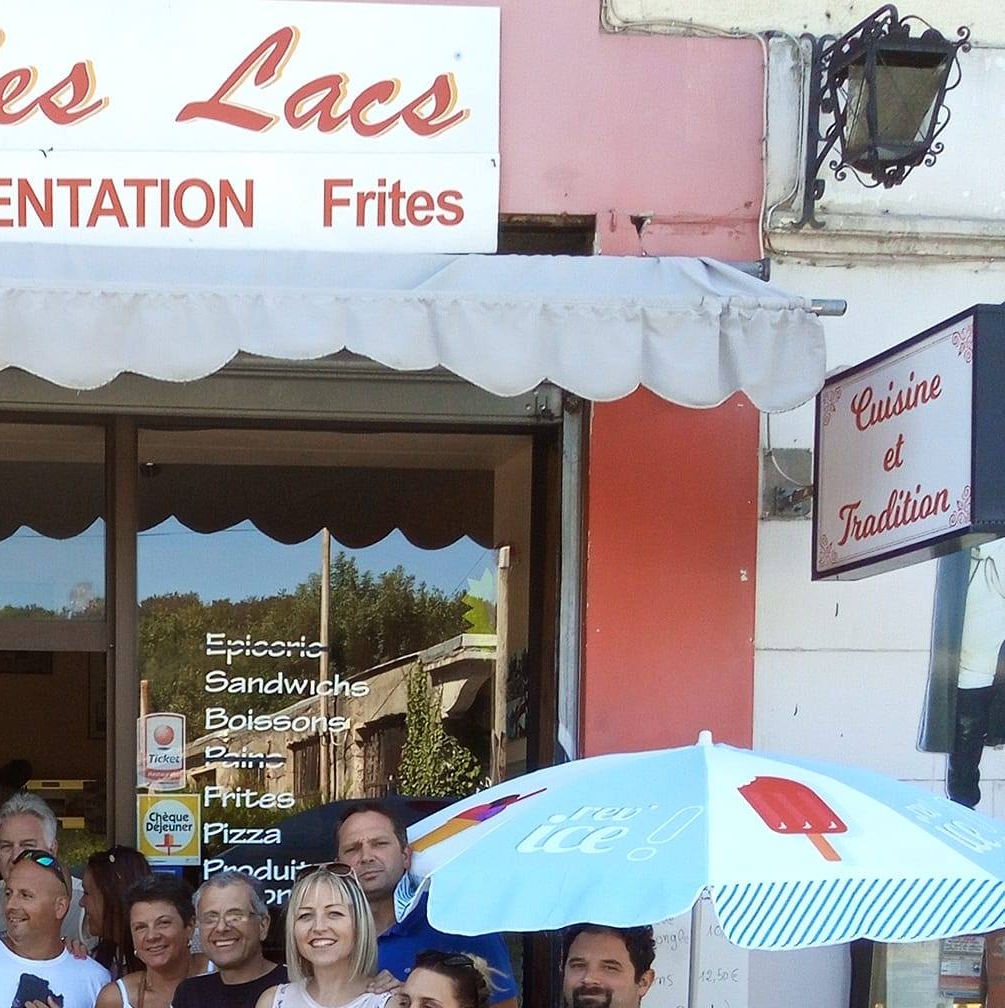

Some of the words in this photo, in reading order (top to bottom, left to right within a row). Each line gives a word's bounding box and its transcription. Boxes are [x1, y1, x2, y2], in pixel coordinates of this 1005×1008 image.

[176, 25, 471, 138] Lacs
[323, 178, 465, 228] Frites
[850, 371, 943, 432] Cuisine
[883, 433, 905, 472] et
[837, 484, 951, 547] Tradition
[205, 670, 370, 697] Sandwichs
[205, 707, 348, 732] Boissons
[148, 754, 181, 764] Ticket
[204, 785, 295, 809] Frites
[145, 821, 193, 834] Déjeuner
[149, 811, 189, 823] Chèque
[203, 823, 282, 845] Pizza
